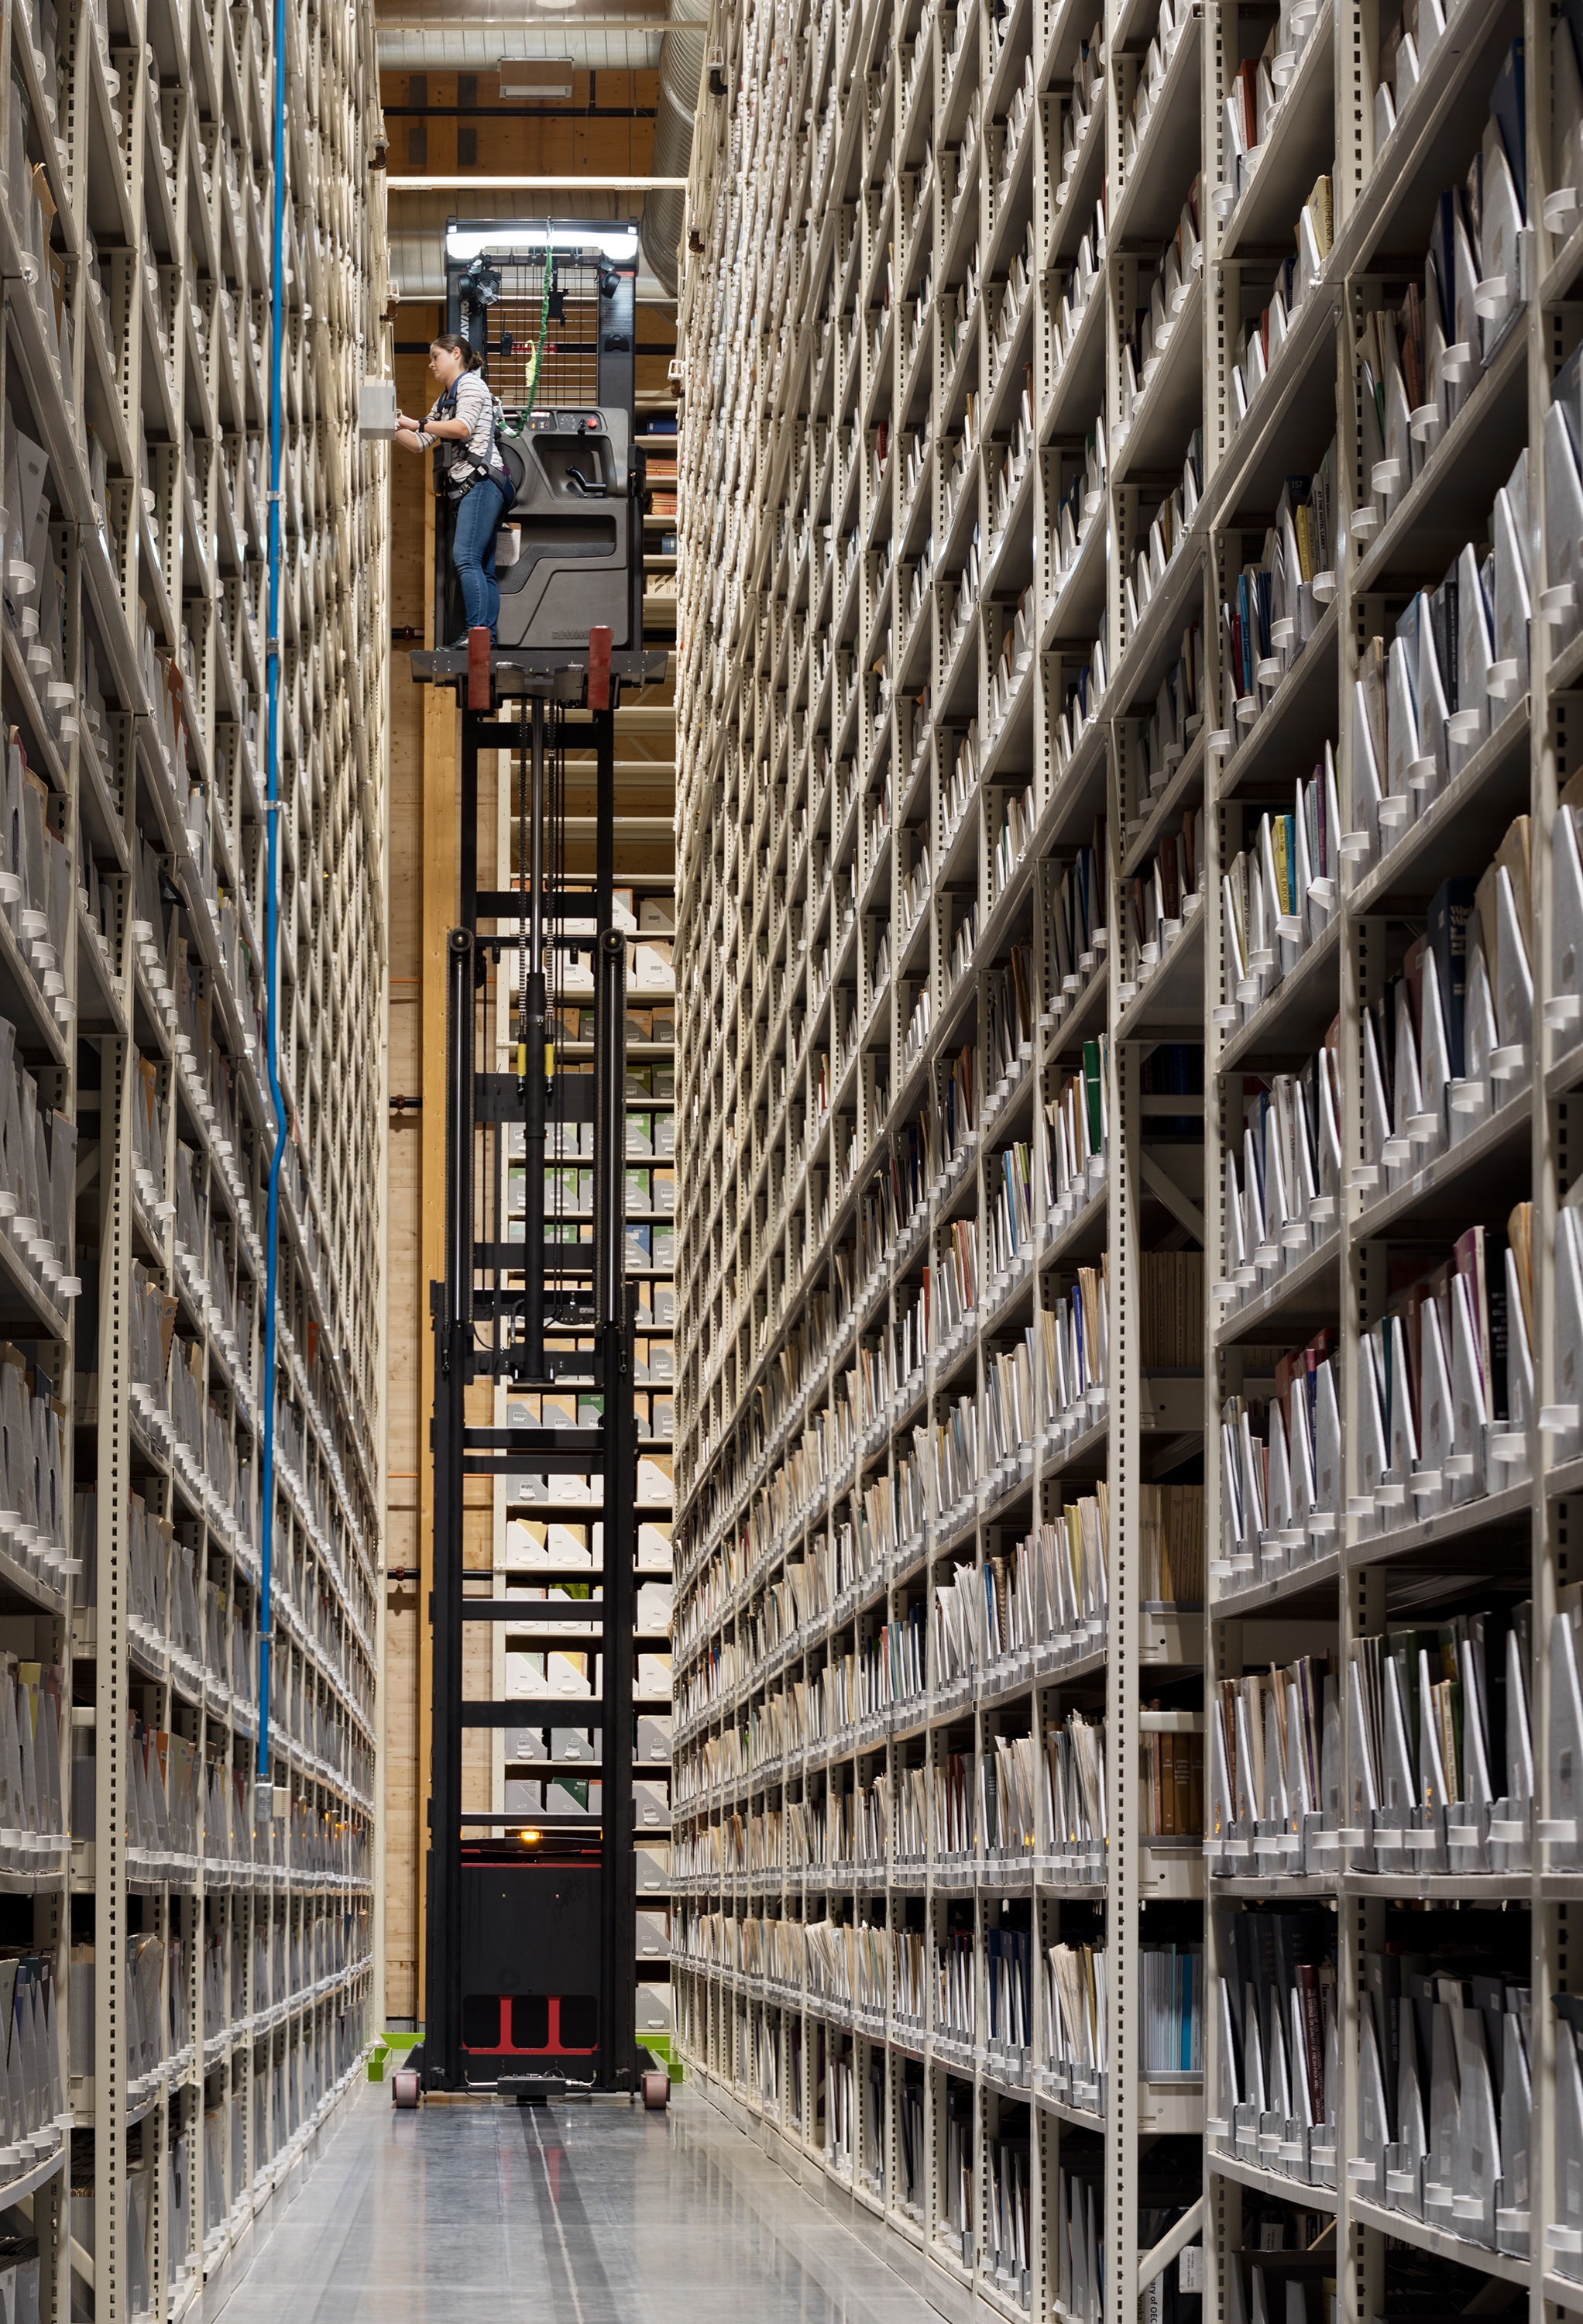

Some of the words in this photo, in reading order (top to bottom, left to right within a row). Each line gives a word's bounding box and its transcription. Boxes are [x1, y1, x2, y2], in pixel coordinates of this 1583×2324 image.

[461, 298, 469, 342] RAYMO
[1291, 480, 1303, 489] 157
[1281, 882, 1289, 910] POPCORN
[1150, 2296, 1158, 2305] of
